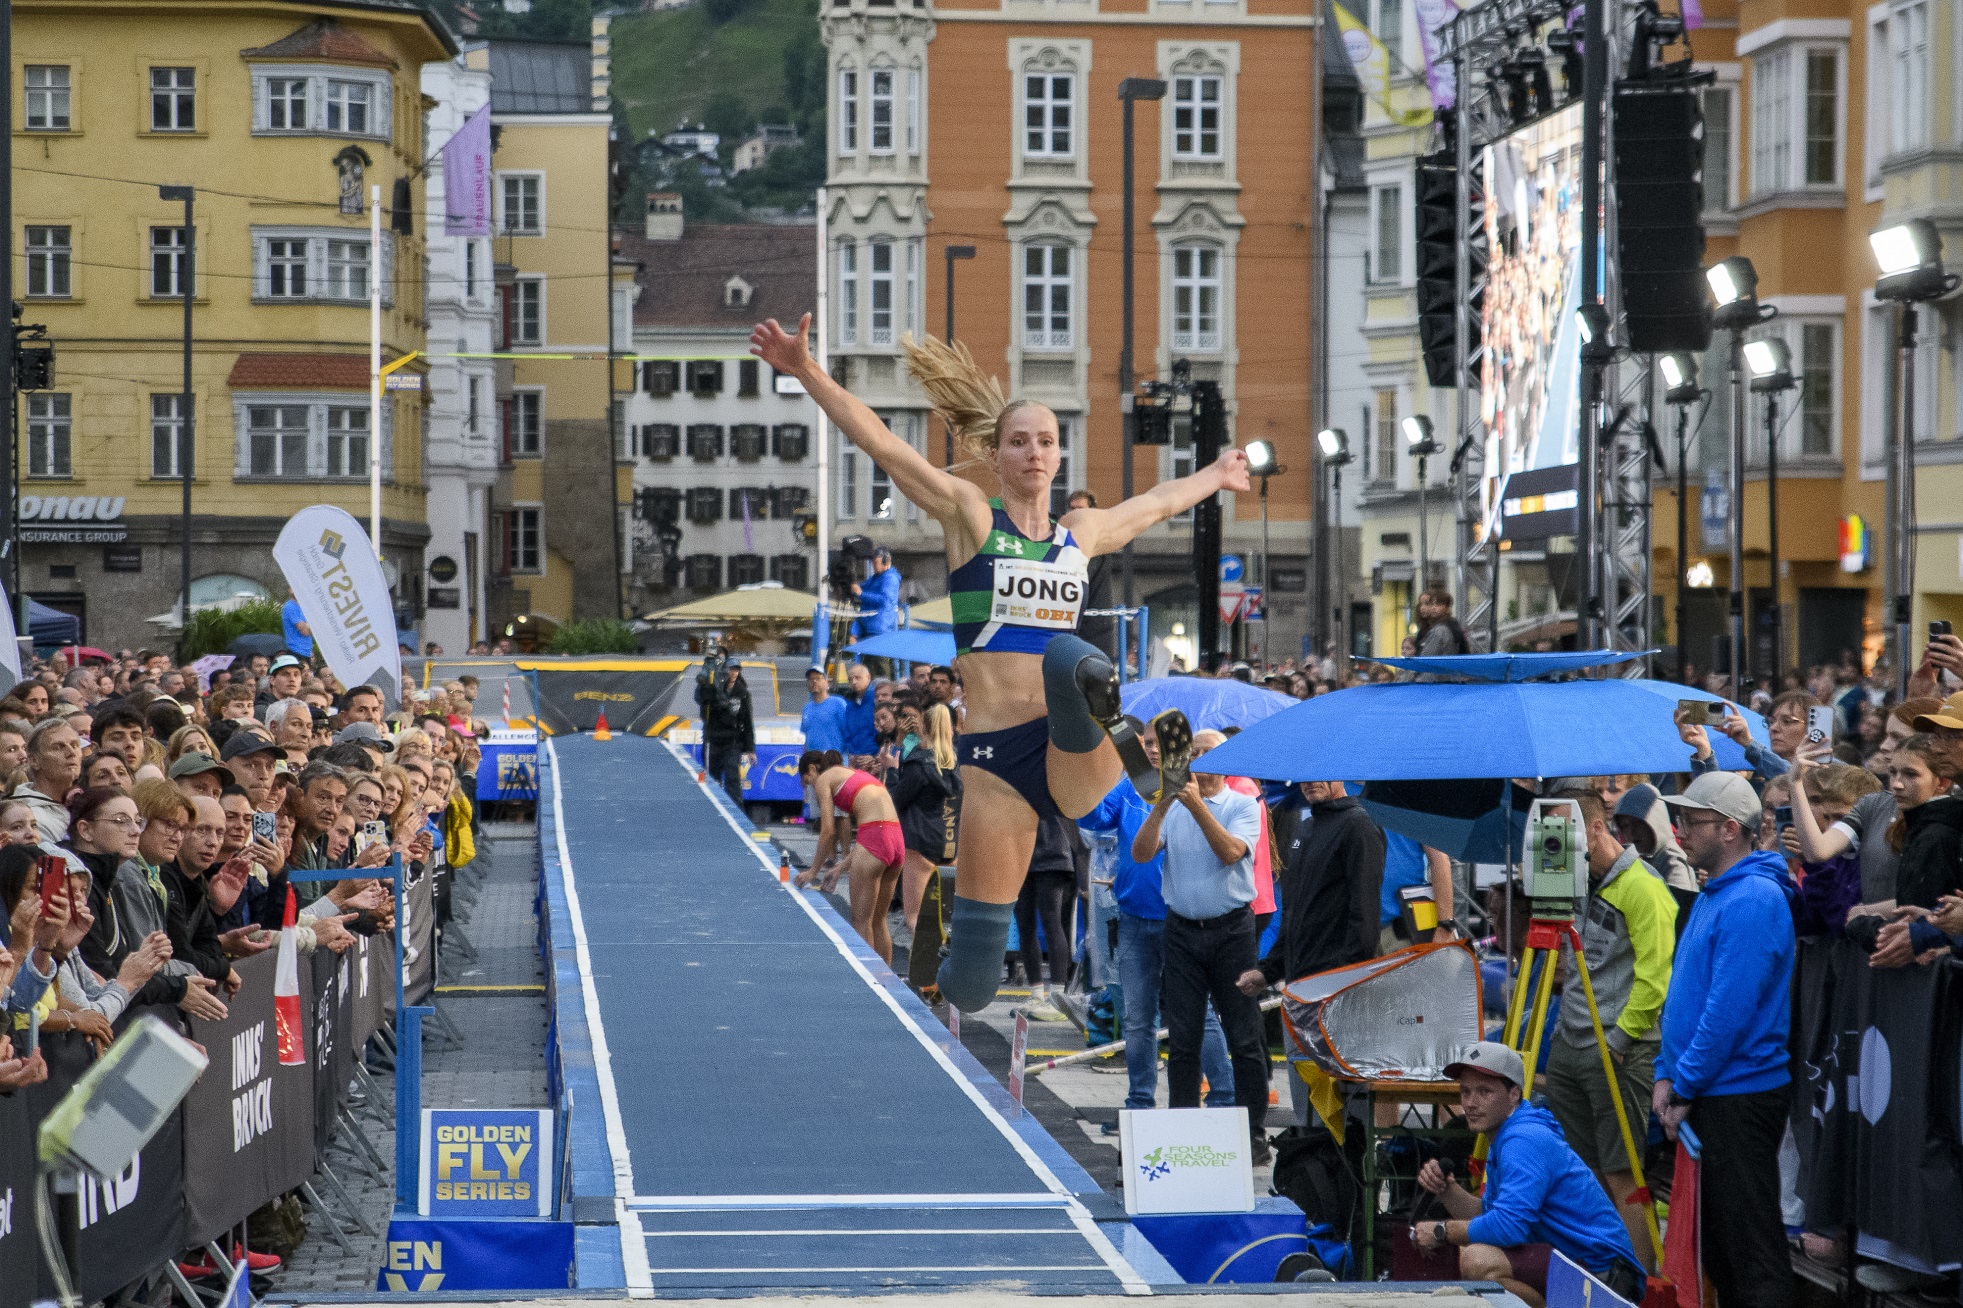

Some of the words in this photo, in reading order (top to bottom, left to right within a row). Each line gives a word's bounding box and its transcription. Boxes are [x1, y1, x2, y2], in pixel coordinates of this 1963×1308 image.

[20, 496, 126, 520] onau
[20, 532, 82, 542] NSURANCE
[85, 532, 126, 542] GROUP
[998, 576, 1079, 603] JONG
[1035, 608, 1075, 622] OBI
[437, 1125, 532, 1143] GOLDEN
[1164, 1152, 1237, 1161] SEASONS
[1169, 1145, 1212, 1153] FOUR
[438, 1143, 533, 1180] FLY
[1171, 1159, 1230, 1167] TRAVEL
[436, 1182, 532, 1201] SERIES
